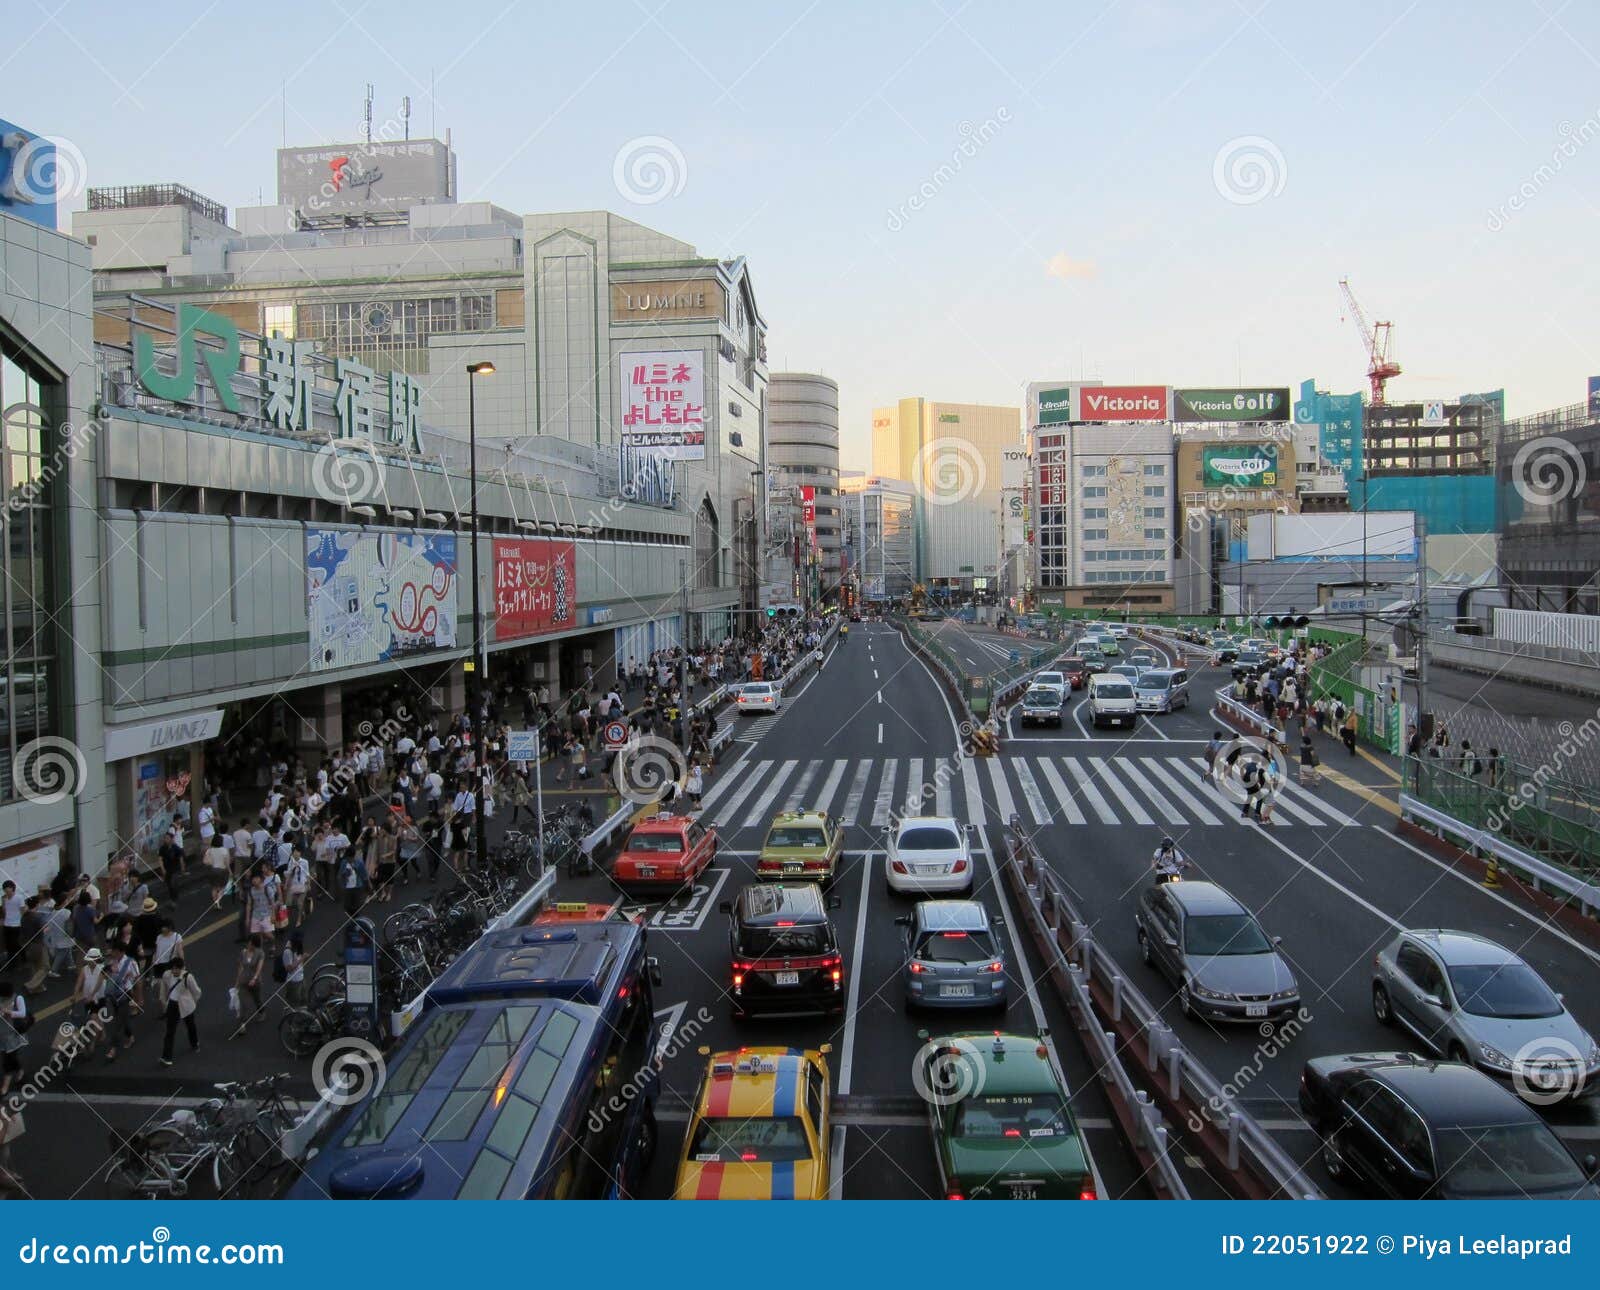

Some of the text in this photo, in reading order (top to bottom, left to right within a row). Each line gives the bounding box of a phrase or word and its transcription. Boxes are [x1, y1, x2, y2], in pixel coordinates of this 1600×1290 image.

[627, 294, 705, 311] LUMINE
[133, 302, 240, 414] JR
[632, 363, 692, 385] ルミネ
[262, 329, 425, 454] 新宿駅
[643, 387, 684, 402] the
[1087, 395, 1160, 411] Victoria
[1190, 393, 1274, 410] Victoria Golf
[623, 403, 703, 425] よしもと
[1241, 460, 1266, 469] Golf
